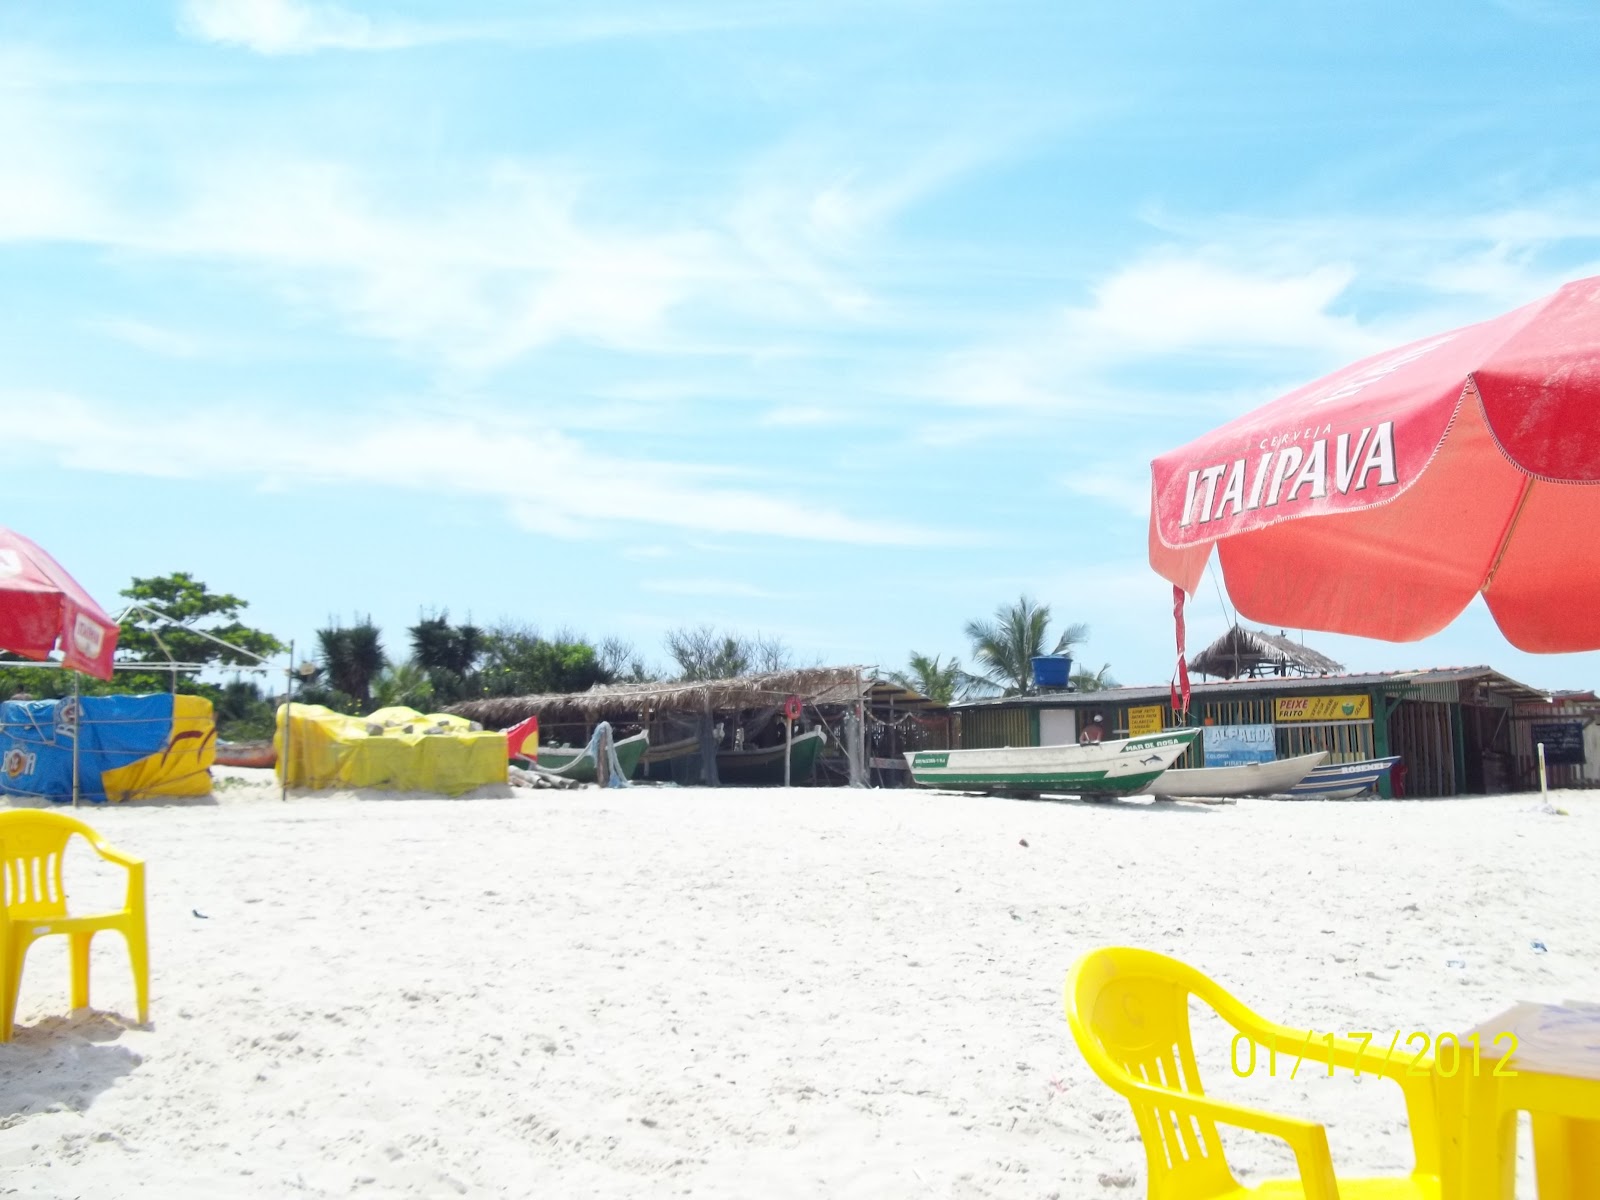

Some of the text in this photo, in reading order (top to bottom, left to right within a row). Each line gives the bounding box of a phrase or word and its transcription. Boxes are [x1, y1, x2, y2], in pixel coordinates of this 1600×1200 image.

[1260, 423, 1331, 449] CERVEJA
[1180, 421, 1398, 528] ITAIPAVA
[1280, 699, 1309, 710] PEIXE
[1126, 738, 1179, 752] MAR DE ROSA
